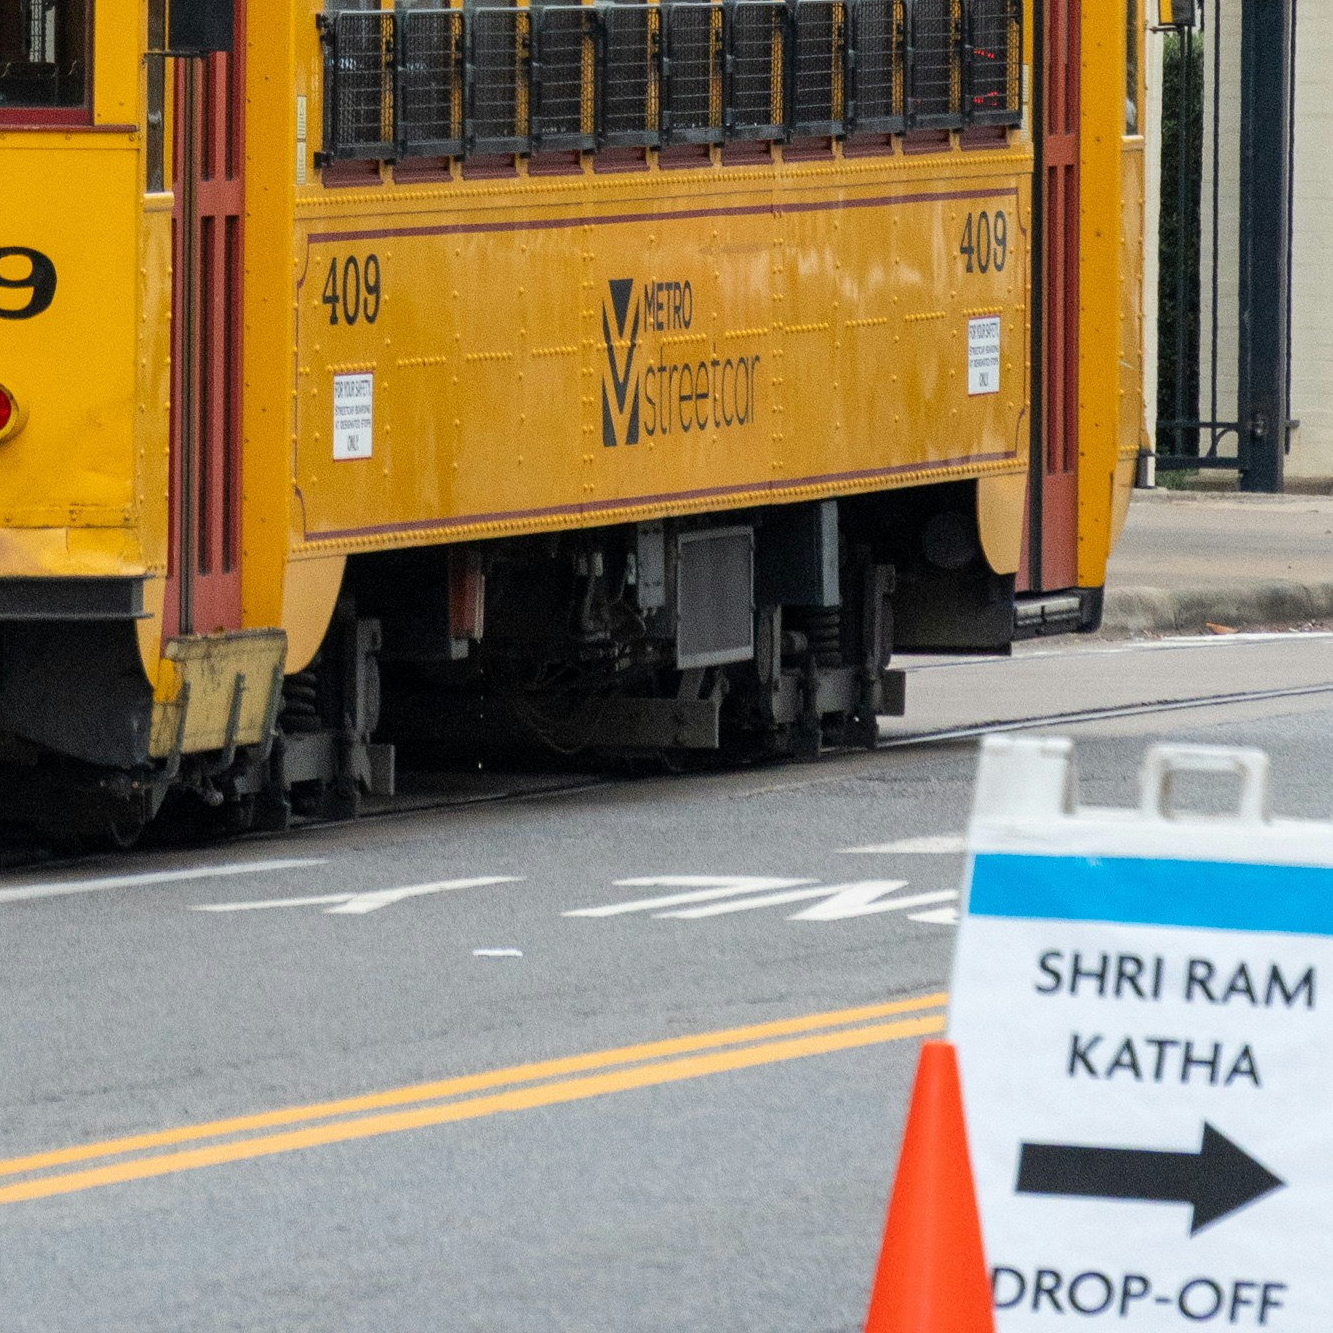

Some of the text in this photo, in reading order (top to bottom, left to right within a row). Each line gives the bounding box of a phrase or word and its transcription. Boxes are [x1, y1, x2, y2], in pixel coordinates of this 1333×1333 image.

[959, 210, 1007, 274] 409
[322, 254, 381, 325] 409
[643, 279, 693, 333] METRO
[644, 342, 761, 436] streetcar
[1034, 948, 1317, 1011] SHRI RAM
[1067, 1030, 1263, 1090] KATHA
[990, 1266, 1288, 1326] DROP-OFF
